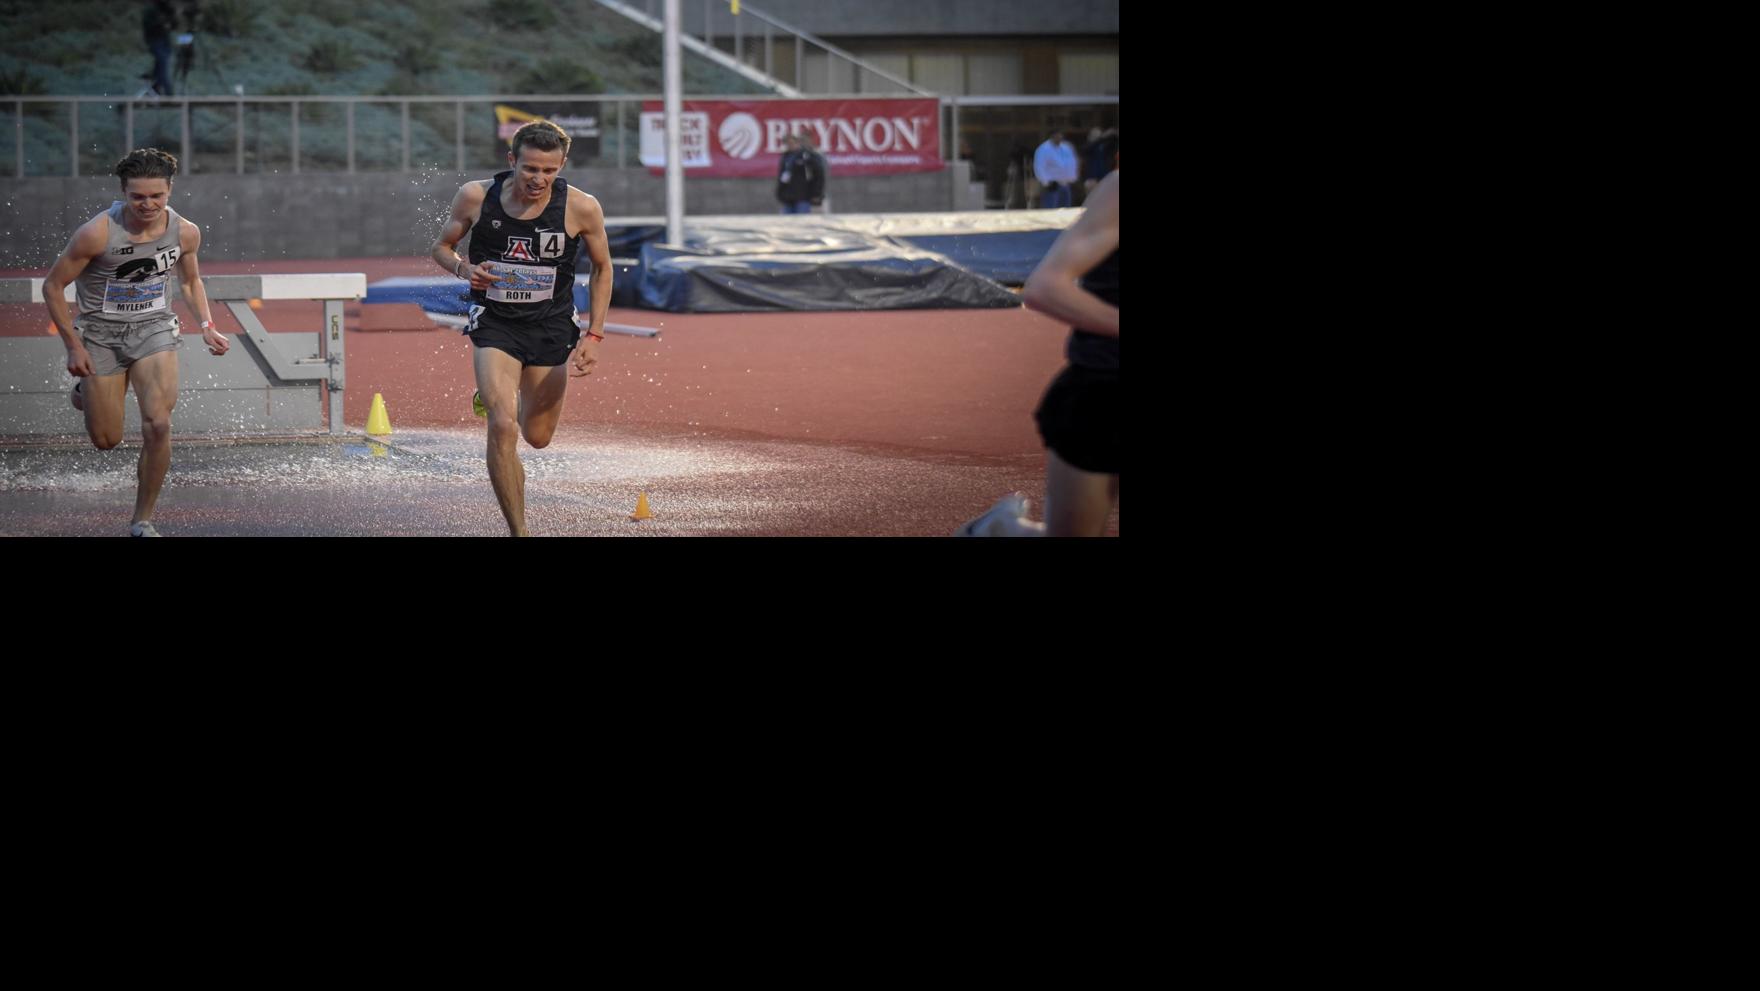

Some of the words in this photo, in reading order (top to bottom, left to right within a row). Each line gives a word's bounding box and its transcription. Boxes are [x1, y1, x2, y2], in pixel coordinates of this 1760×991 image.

[544, 234, 560, 257] 4
[160, 249, 177, 269] 15
[506, 291, 532, 300] ROTH
